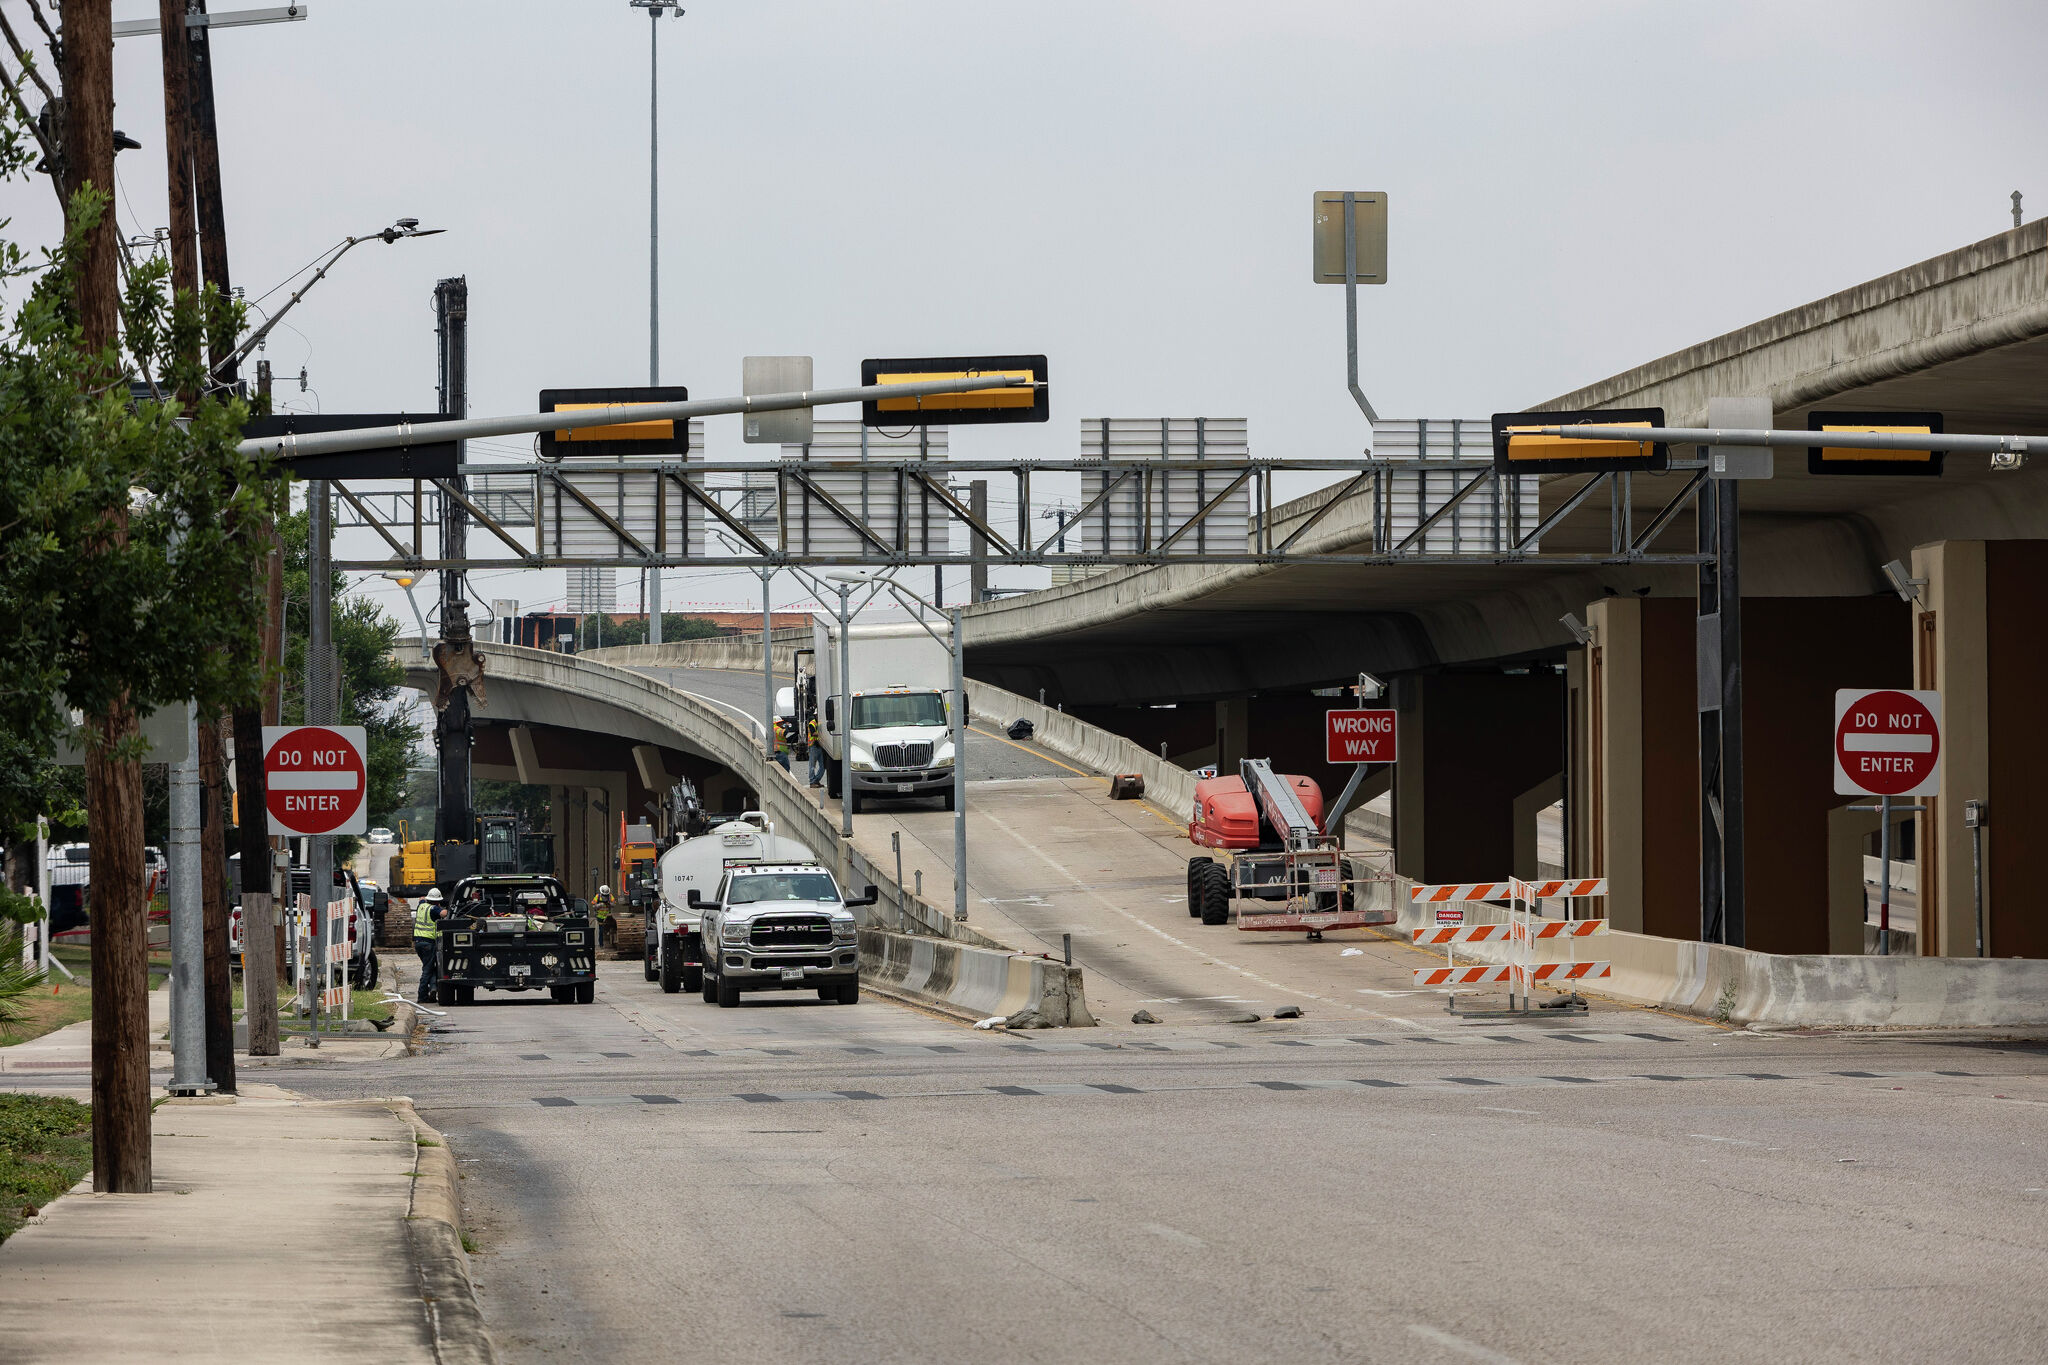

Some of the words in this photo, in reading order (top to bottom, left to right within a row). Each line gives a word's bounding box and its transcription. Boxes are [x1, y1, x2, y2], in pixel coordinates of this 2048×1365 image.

[1332, 717, 1392, 733] WRONG
[1855, 712, 1878, 728] DO
[1888, 713, 1923, 729] NOT
[1344, 739, 1380, 755] WAY
[279, 750, 302, 766] DO
[312, 750, 347, 766] NOT
[1860, 757, 1914, 773] ENTER
[285, 795, 340, 811] ENTER
